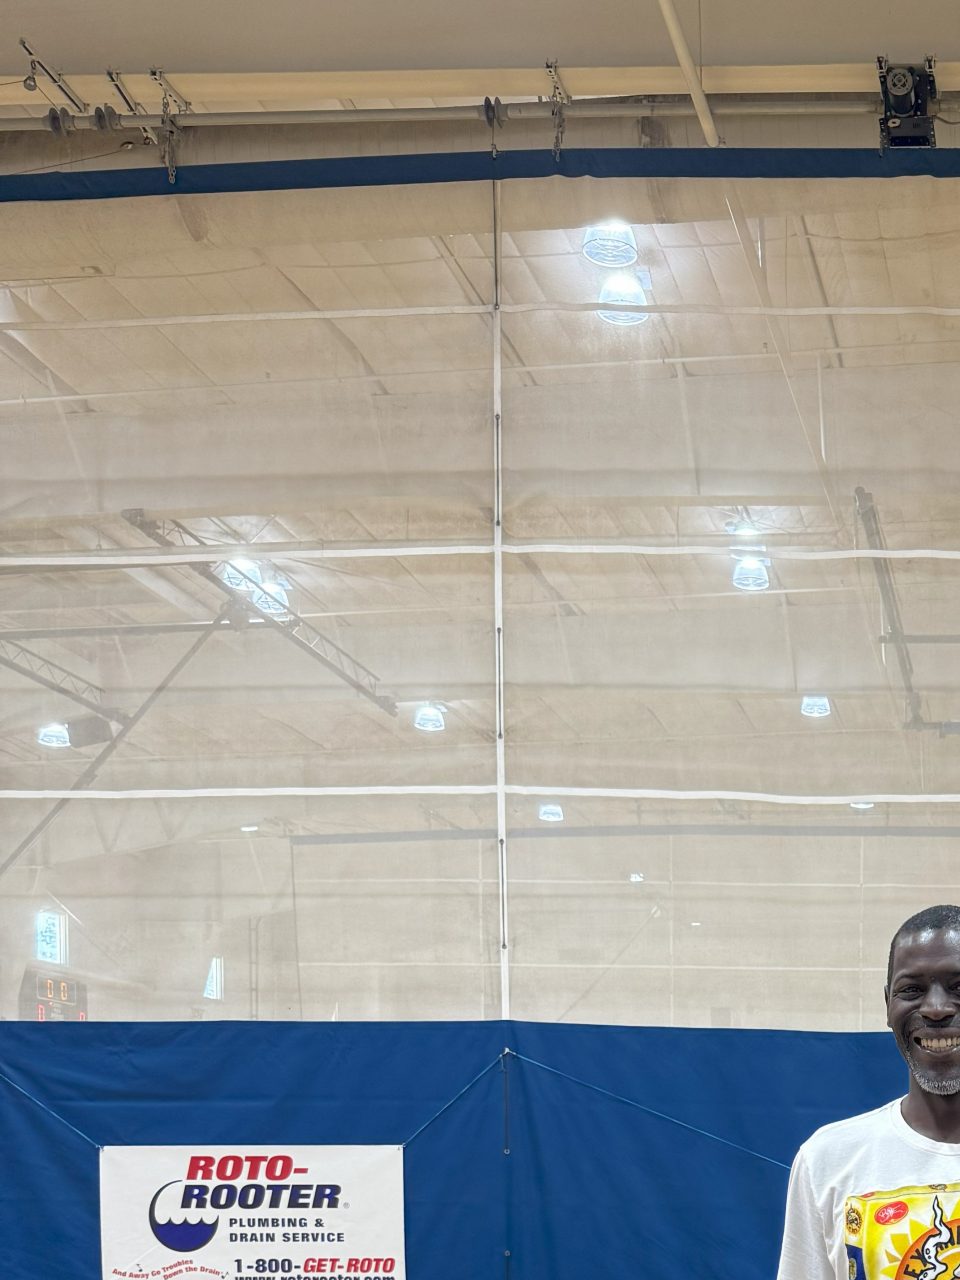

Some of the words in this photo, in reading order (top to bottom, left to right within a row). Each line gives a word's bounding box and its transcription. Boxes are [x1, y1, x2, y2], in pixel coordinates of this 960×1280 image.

[186, 1155, 309, 1181] ROTO-
[229, 1218, 308, 1228] PLUMBING
[314, 1218, 325, 1228] &
[229, 1232, 276, 1243] DRAIN
[282, 1232, 345, 1243] SERVICE
[112, 1268, 127, 1277] And
[162, 1259, 194, 1273] Troubles
[234, 1257, 396, 1274] 1-800-GET-ROTO
[163, 1267, 184, 1280] Down
